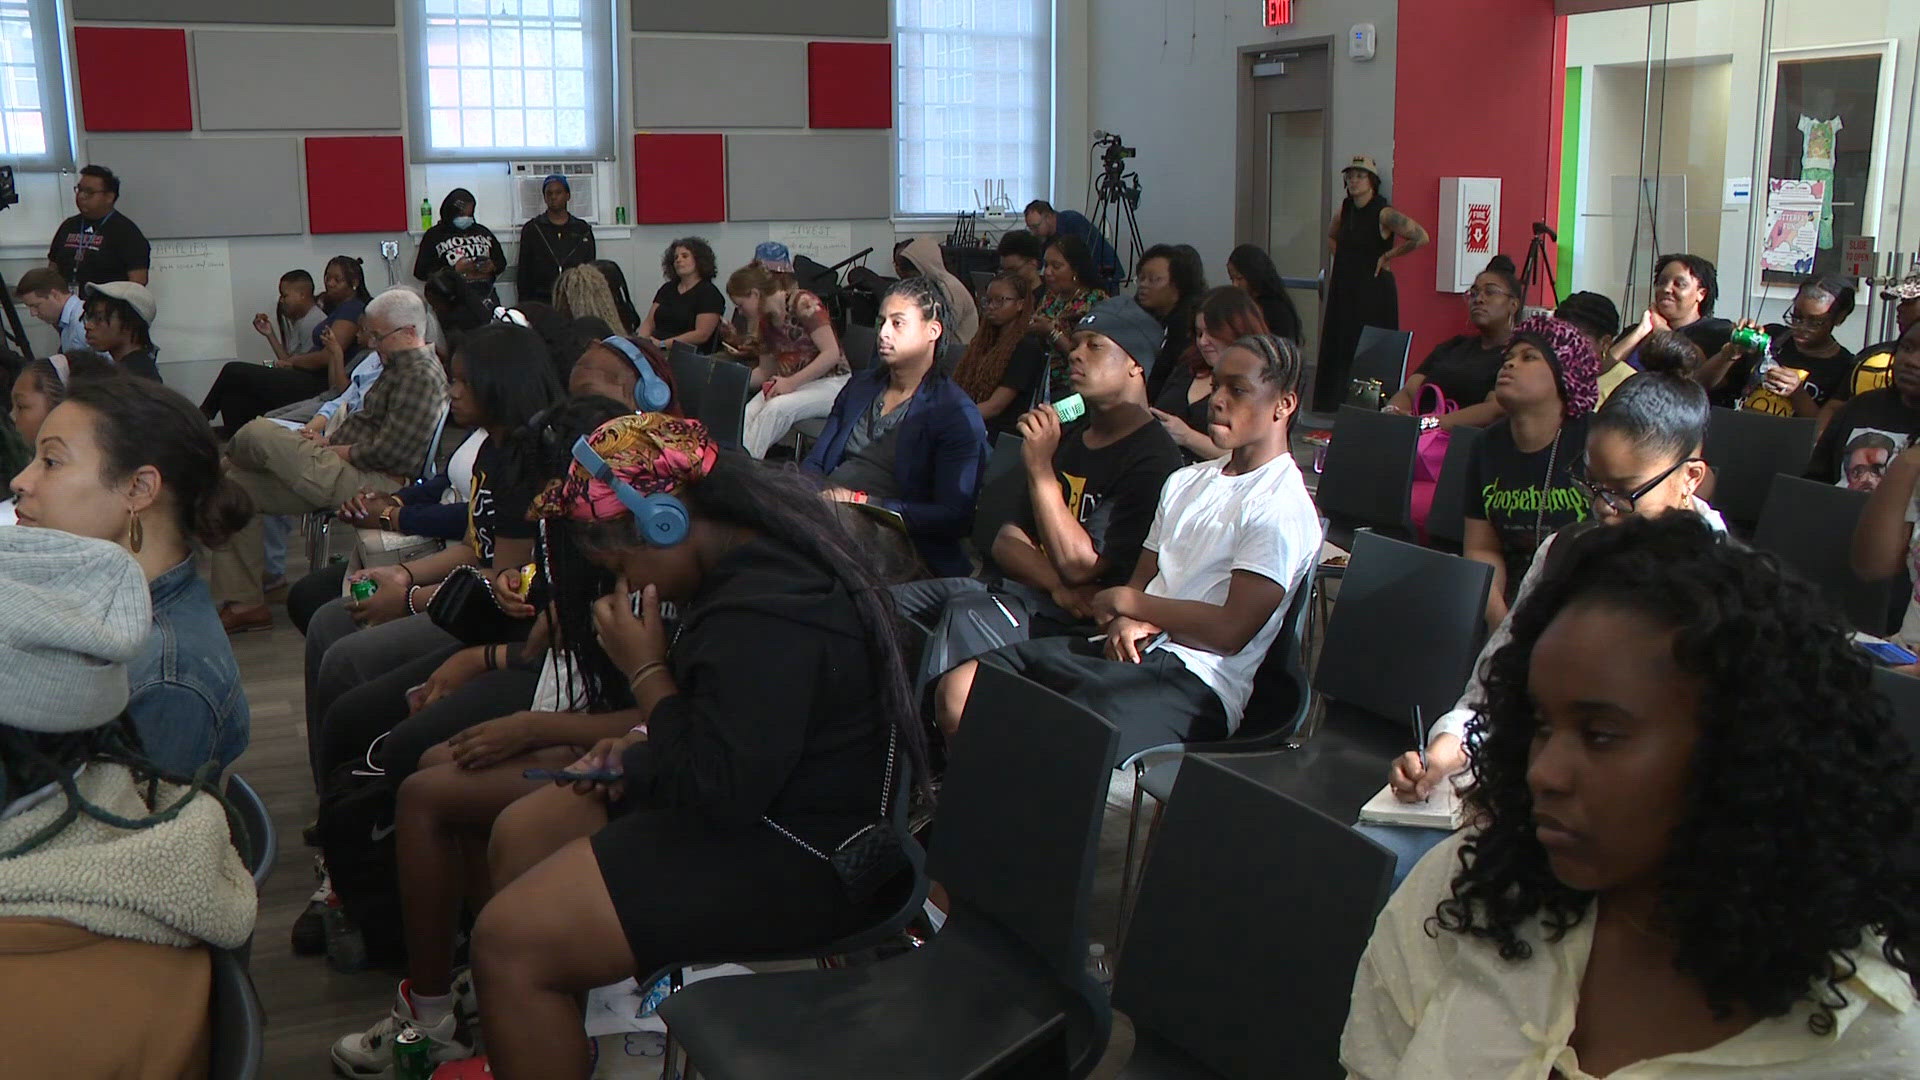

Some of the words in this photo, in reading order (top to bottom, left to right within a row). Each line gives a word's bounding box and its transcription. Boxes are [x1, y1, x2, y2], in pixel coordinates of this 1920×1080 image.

[1268, 0, 1288, 25] EXIT
[1849, 240, 1867, 250] SLIDE
[1854, 253, 1869, 261] OPEN
